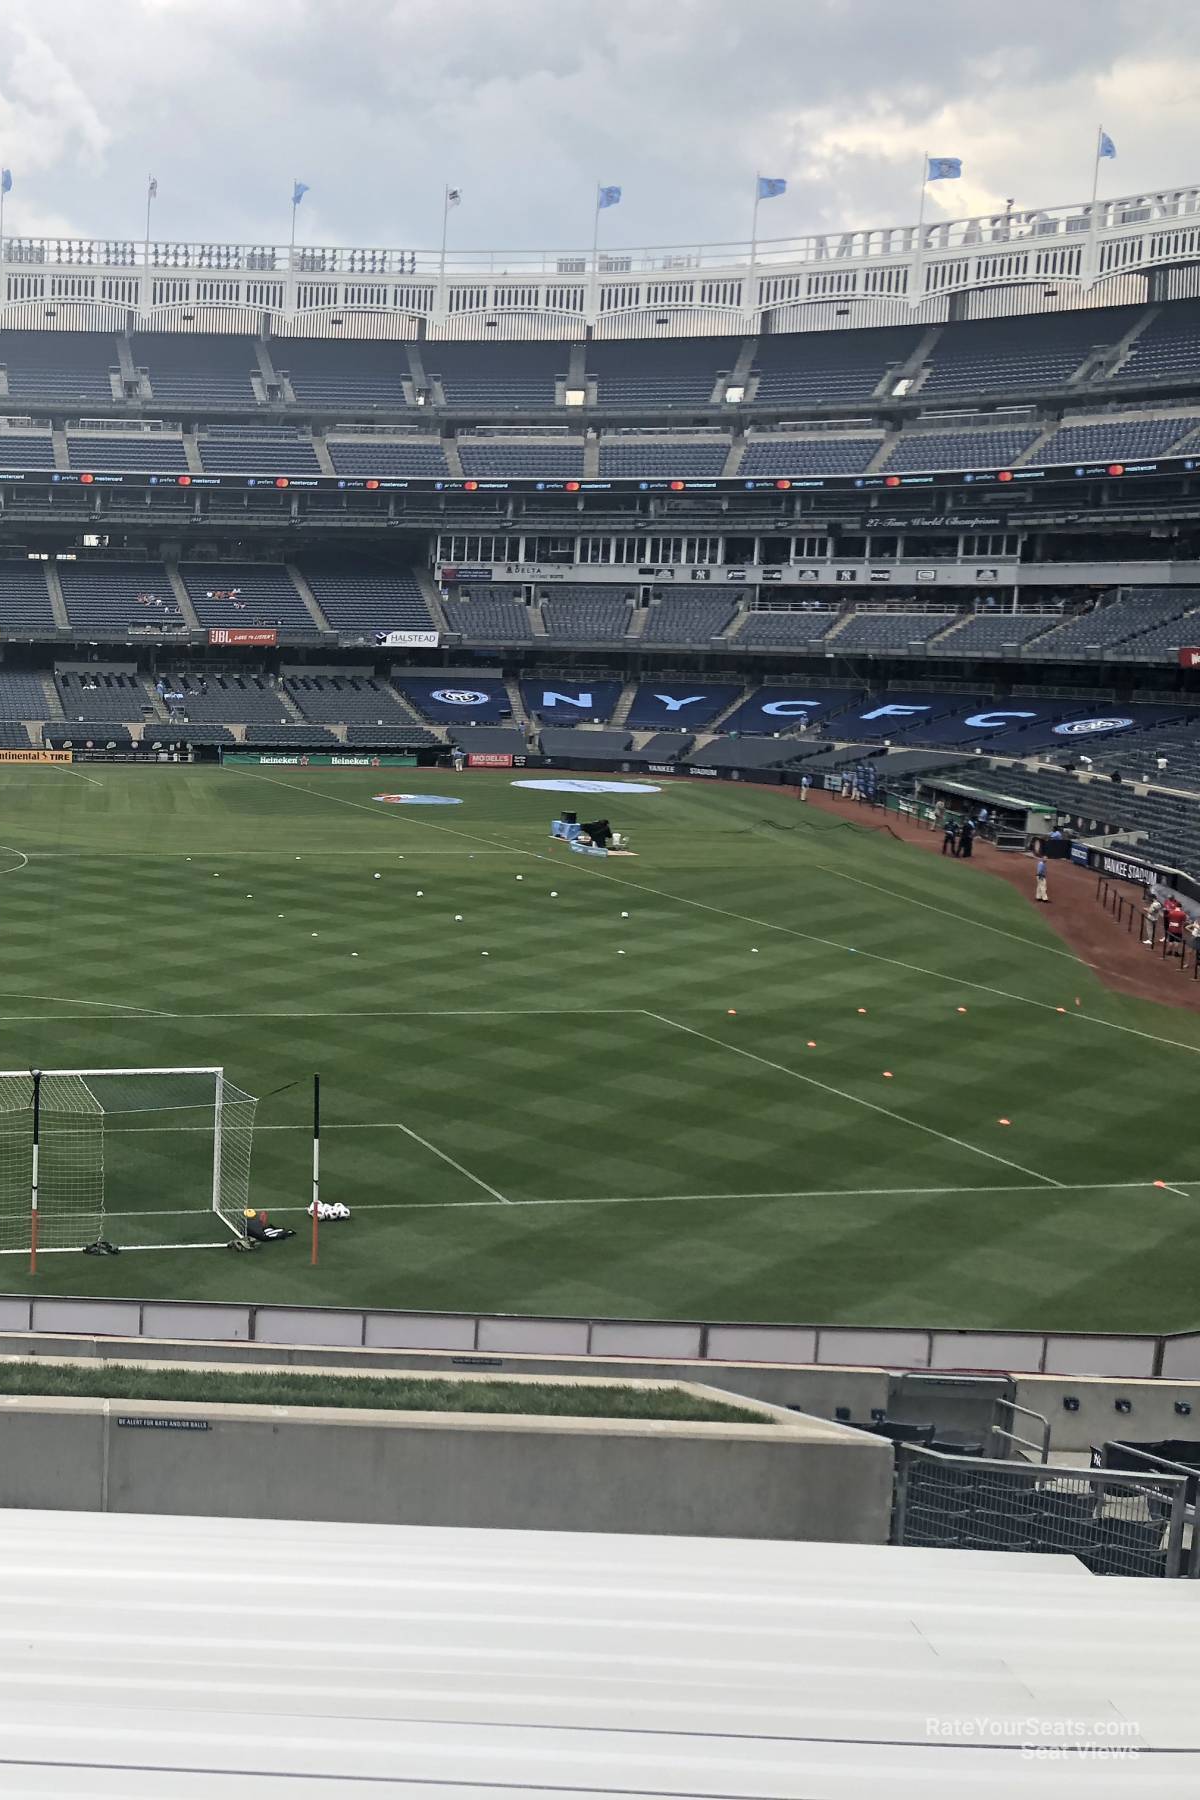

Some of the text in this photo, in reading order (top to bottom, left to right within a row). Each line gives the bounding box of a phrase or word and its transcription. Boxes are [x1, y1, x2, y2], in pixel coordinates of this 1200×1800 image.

[911, 517, 944, 526] World
[945, 517, 1000, 528] Champions
[211, 631, 232, 643] JBL
[50, 753, 70, 761] TIRE
[260, 756, 298, 764] Heineken
[331, 756, 369, 765] Heineken
[648, 764, 717, 776] YANKEE STADIUM
[1104, 856, 1157, 885] YANKEE STADIUM
